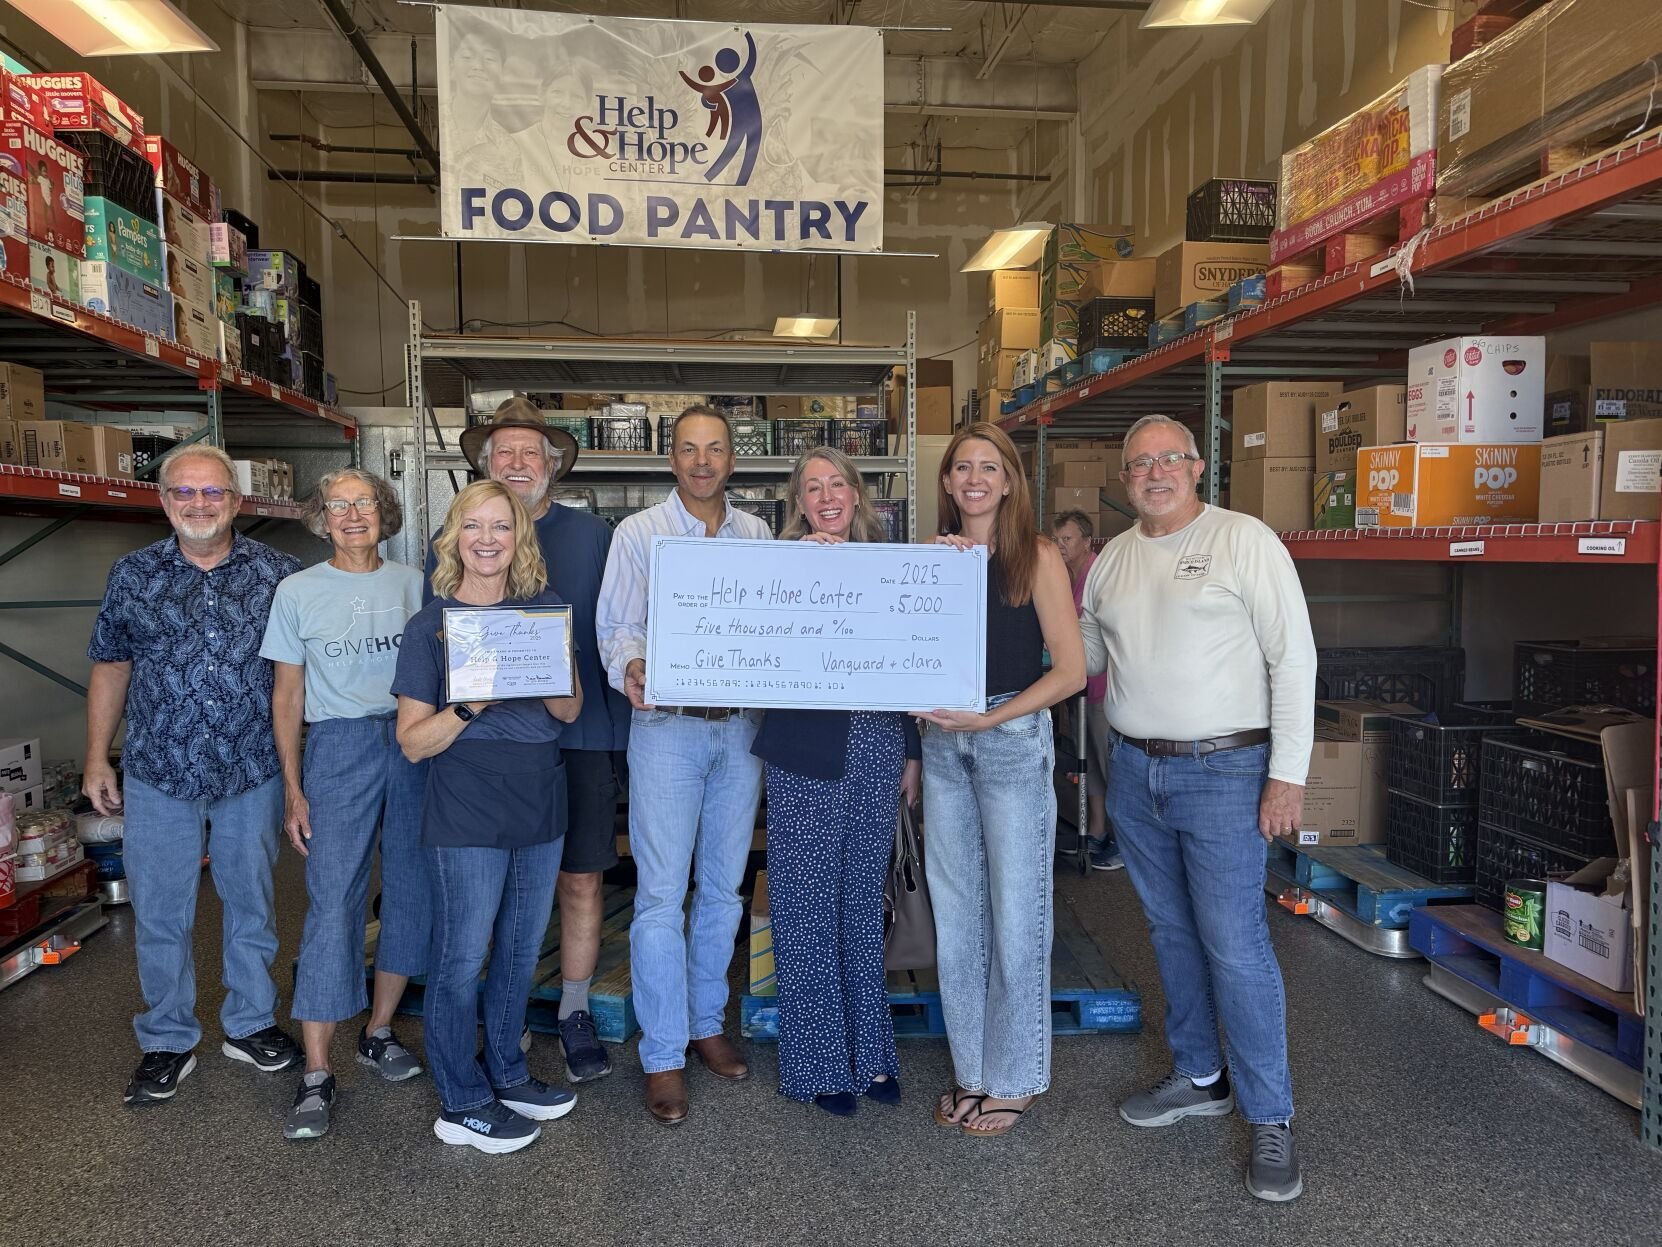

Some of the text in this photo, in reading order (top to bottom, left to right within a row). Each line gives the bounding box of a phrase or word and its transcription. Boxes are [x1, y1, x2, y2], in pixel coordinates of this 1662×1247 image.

[81, 116, 88, 124] 5
[595, 94, 679, 140] Help
[23, 125, 84, 177] HUGGIES
[567, 115, 709, 174] & Hope
[609, 161, 665, 174] CENTER
[460, 187, 869, 242] FOOD PANTRY
[118, 217, 147, 248] Pampers
[1487, 343, 1520, 354] CHIPS
[1369, 469, 1399, 491] POP
[1474, 467, 1517, 489] POP
[901, 562, 941, 585] 2025
[710, 576, 747, 606] Help
[768, 579, 802, 605] Hope
[809, 581, 863, 609] Center
[898, 594, 943, 614] 5,000
[728, 617, 794, 635] thousand
[800, 624, 824, 635] and
[470, 656, 490, 664] Help
[501, 655, 522, 663] Hope
[695, 649, 781, 669] Give Thanks
[821, 651, 885, 676] Vanguard
[462, 1116, 492, 1135] HOKA
